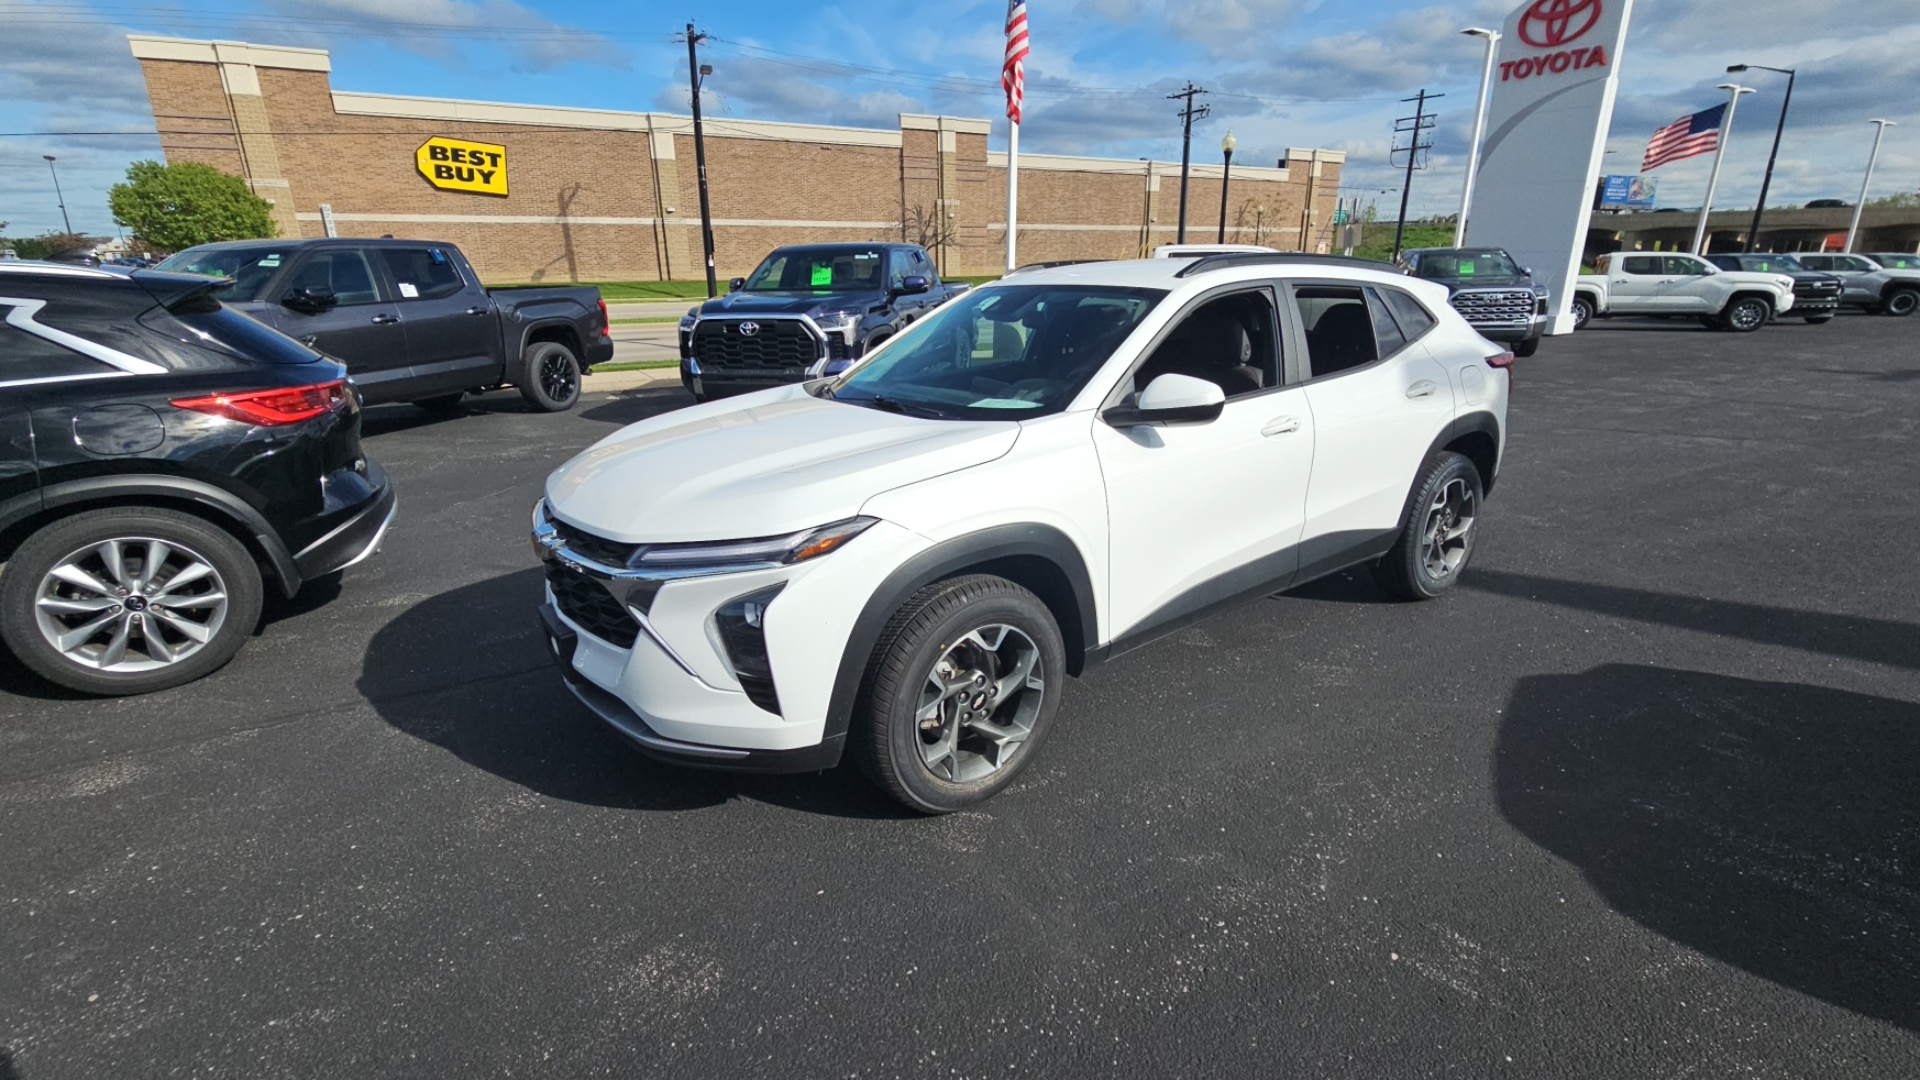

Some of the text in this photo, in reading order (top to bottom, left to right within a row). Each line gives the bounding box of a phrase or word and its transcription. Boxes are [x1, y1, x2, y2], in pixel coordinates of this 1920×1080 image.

[1500, 45, 1607, 82] TOYOTA
[428, 144, 502, 169] BEST
[434, 163, 497, 185] BUY
